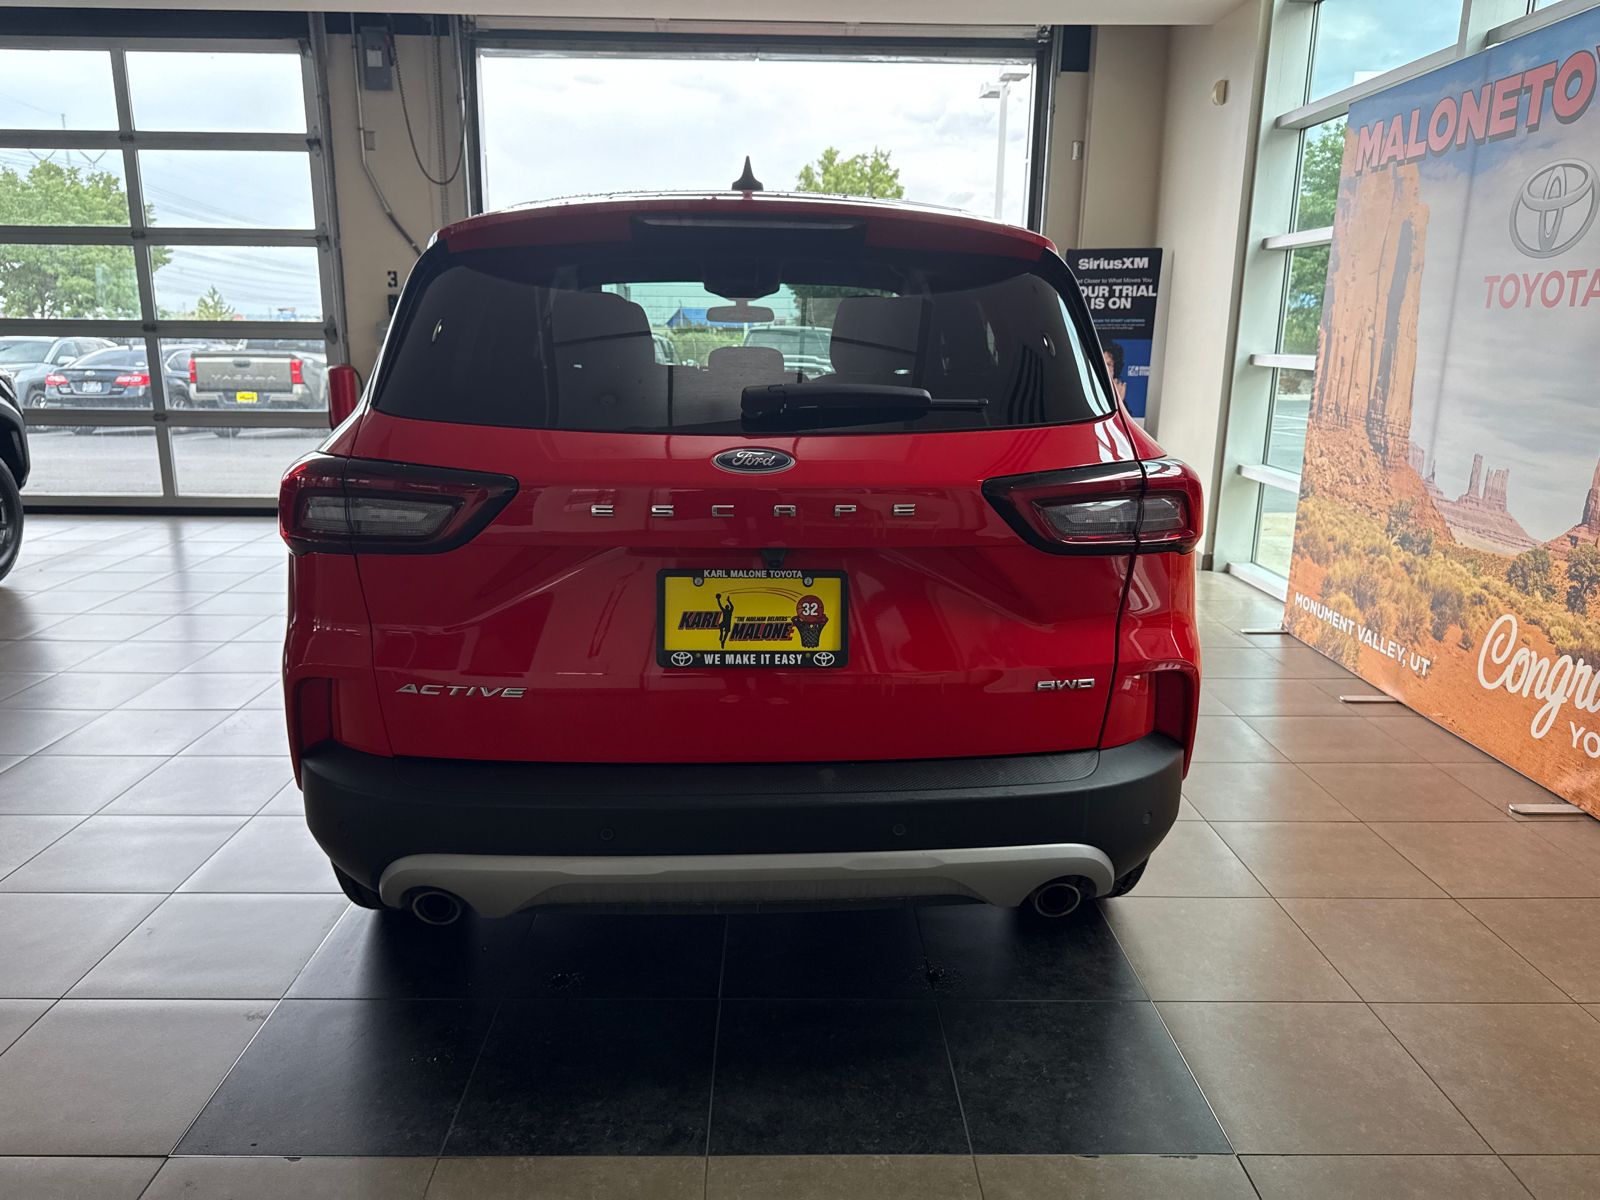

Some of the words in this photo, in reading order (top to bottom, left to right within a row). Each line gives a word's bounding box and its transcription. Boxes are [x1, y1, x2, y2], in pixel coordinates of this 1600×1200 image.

[1354, 45, 1600, 177] MALONETO
[1078, 257, 1149, 270] SiriusXM
[387, 270, 398, 287] 3
[1080, 285, 1109, 297] OUR
[1112, 285, 1157, 297] TRIAL
[1484, 269, 1600, 309] TOYOTA
[1090, 297, 1105, 309] IS
[1108, 297, 1132, 309] ON
[732, 451, 776, 466] Ford
[590, 503, 916, 517] ESCAPE
[703, 569, 728, 578] KARL
[730, 569, 767, 578] MALONE
[769, 570, 803, 578] TOYOTA
[802, 602, 819, 616] 32
[678, 611, 722, 630] KARL
[729, 622, 794, 641] MALONE
[1294, 591, 1356, 636] MONUMENT
[1357, 624, 1407, 668] VALLEY,
[1409, 651, 1431, 677] UT
[703, 653, 721, 665] WE
[725, 653, 757, 665] MAKE
[760, 653, 771, 665] IT
[774, 653, 803, 665] EASY
[395, 683, 528, 698] ACTIVE
[1037, 678, 1095, 691] AWD
